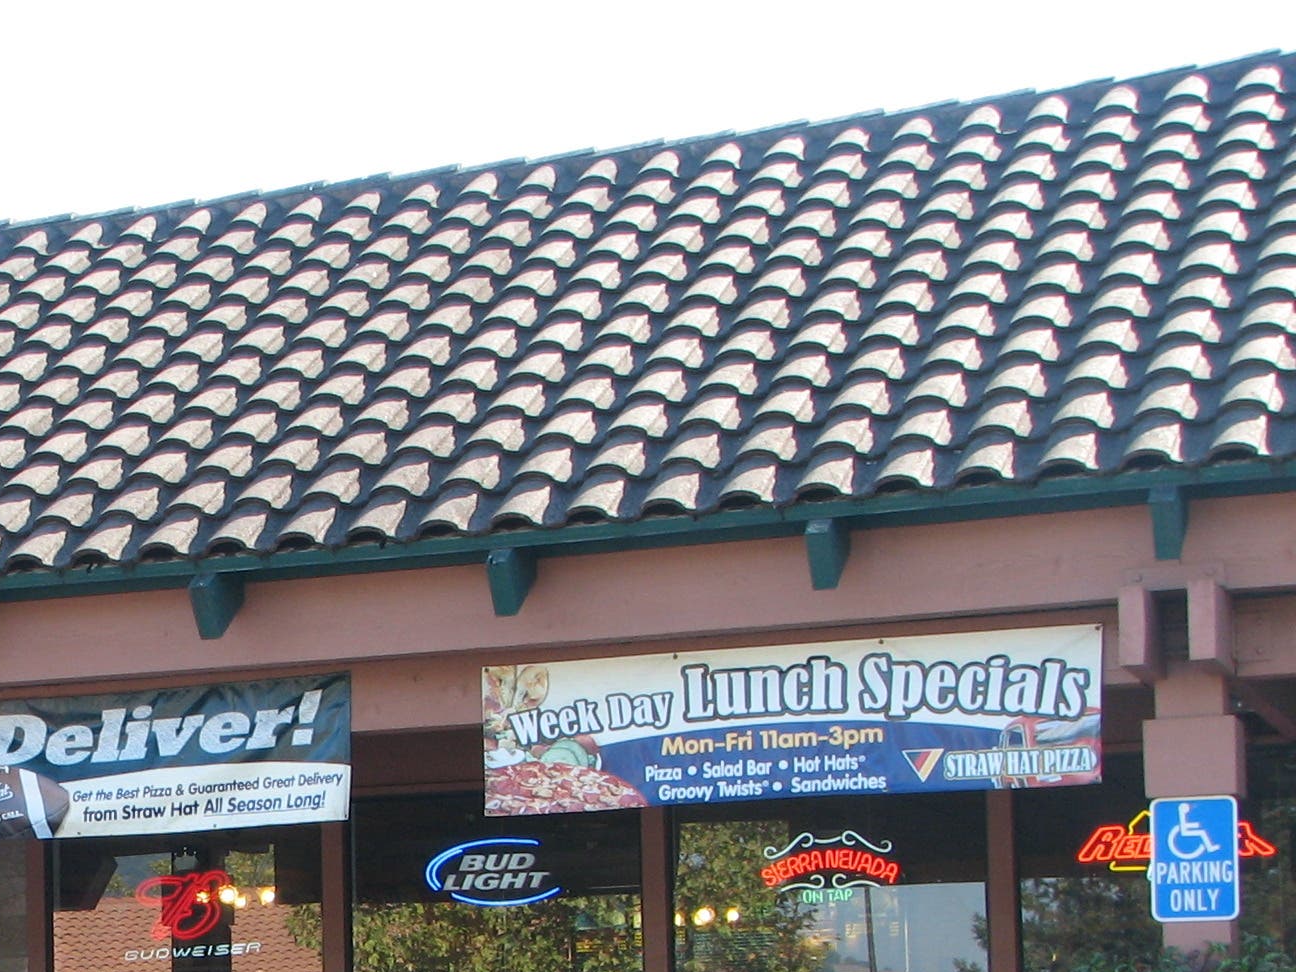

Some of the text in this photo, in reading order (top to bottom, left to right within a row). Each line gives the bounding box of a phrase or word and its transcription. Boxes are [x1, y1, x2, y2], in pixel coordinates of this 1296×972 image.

[508, 652, 1090, 747] Week Day Lunch Specials
[661, 726, 884, 756] Mon-Fri 11am-3pm
[645, 765, 682, 782] Pizza
[703, 760, 743, 779] Salad
[747, 759, 772, 776] Bar
[793, 757, 821, 773] Hot
[944, 747, 1093, 779] STRAW HAT PIZZA
[72, 771, 344, 804] Get the Best Pizza & Guaranteed Great Delivery
[658, 773, 887, 802] Groovy Twists Sandwiches
[82, 791, 327, 823] from Straw Hat All Season Long!
[459, 852, 536, 872] BUD
[761, 848, 901, 888] SIERRA NEVADA
[1157, 860, 1234, 885] PARKING
[442, 871, 552, 892] LIGHT
[802, 888, 853, 904] ON TAP
[1169, 887, 1220, 912] ONLY
[124, 942, 262, 961] BUDWEISER
